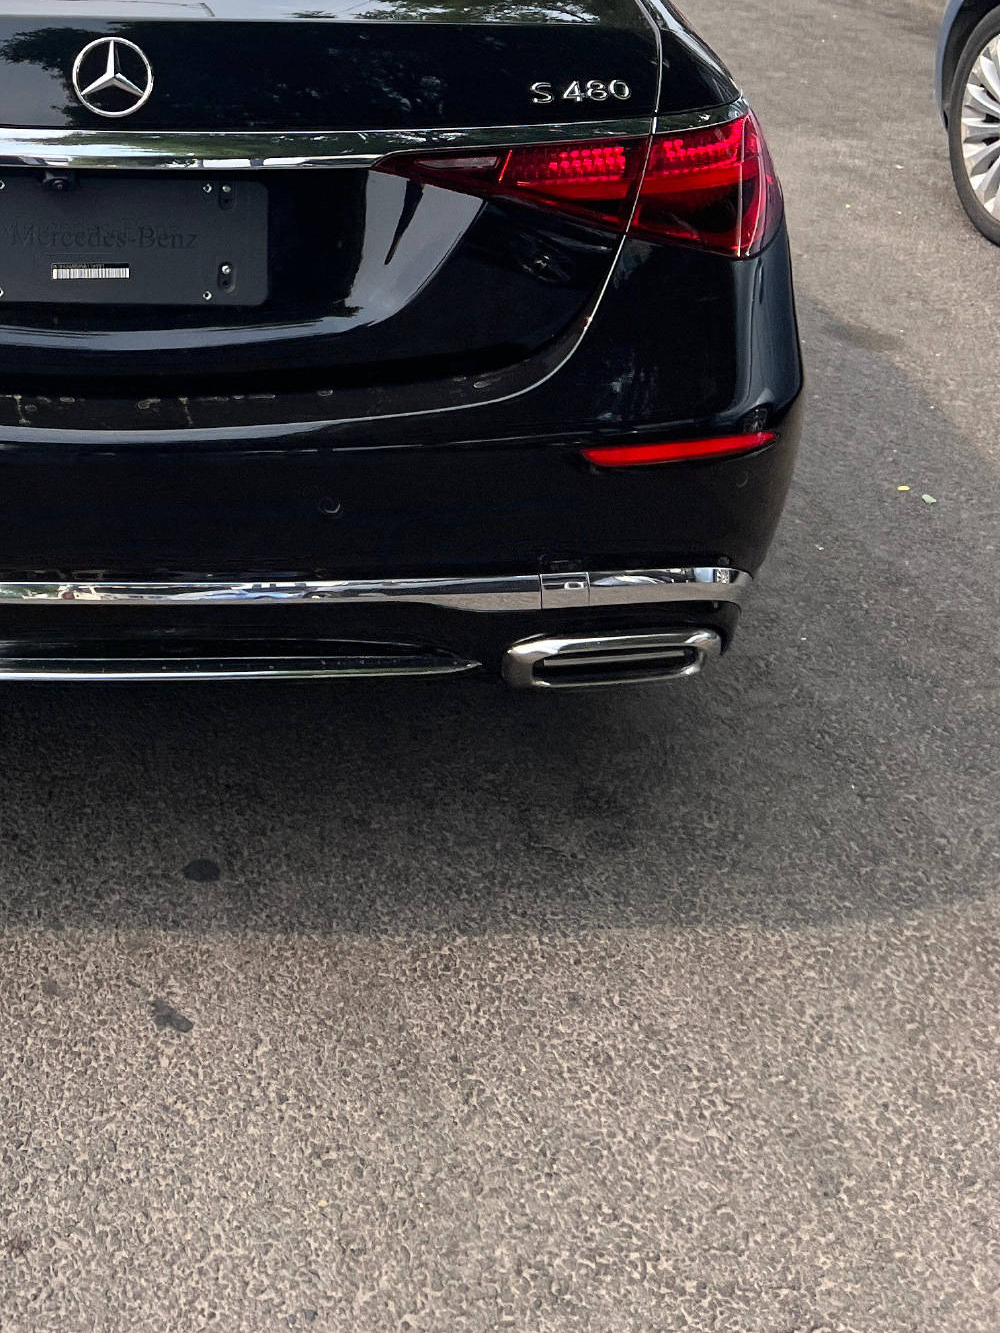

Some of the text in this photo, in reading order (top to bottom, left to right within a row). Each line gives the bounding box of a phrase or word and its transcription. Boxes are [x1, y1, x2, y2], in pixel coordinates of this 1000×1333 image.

[530, 79, 631, 104] S 480
[10, 223, 198, 250] Mercedes-Benz
